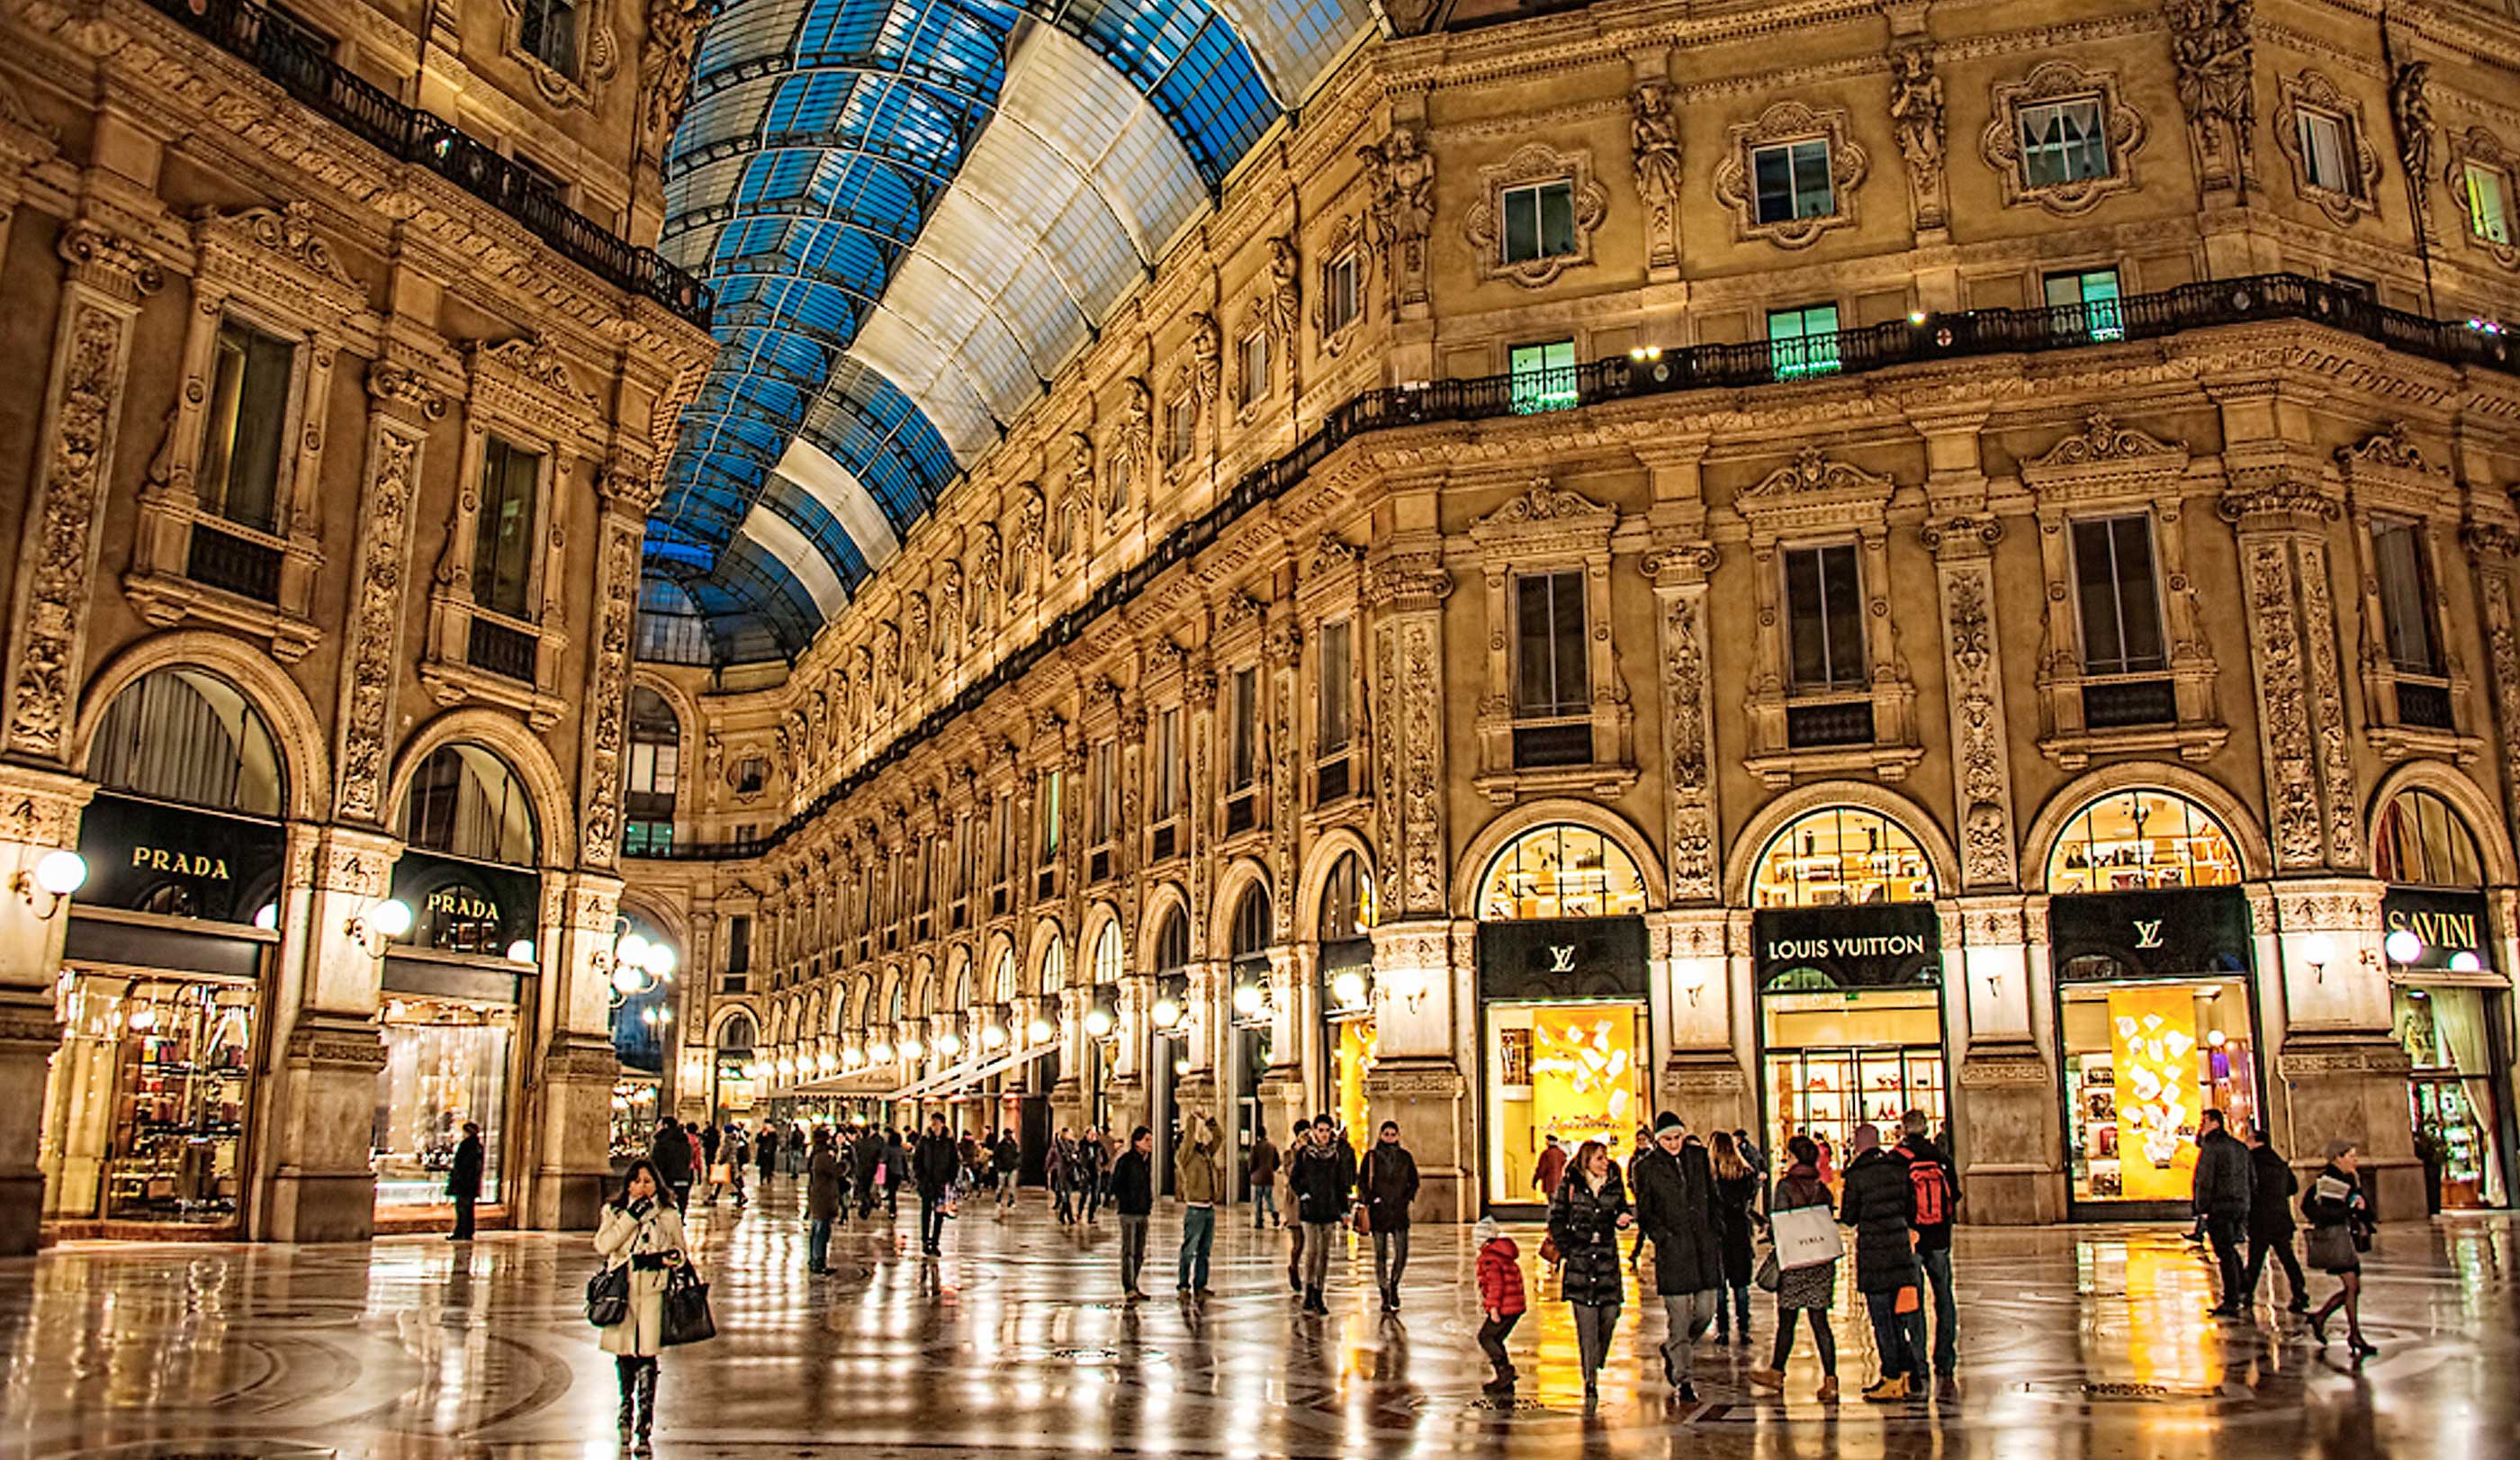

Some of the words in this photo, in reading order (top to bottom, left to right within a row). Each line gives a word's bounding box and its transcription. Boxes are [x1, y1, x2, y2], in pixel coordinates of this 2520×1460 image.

[132, 846, 230, 879] PRADA
[428, 893, 500, 921] PRADA
[1768, 940, 1830, 960] LOUIS
[1832, 934, 1926, 957] VUITTON
